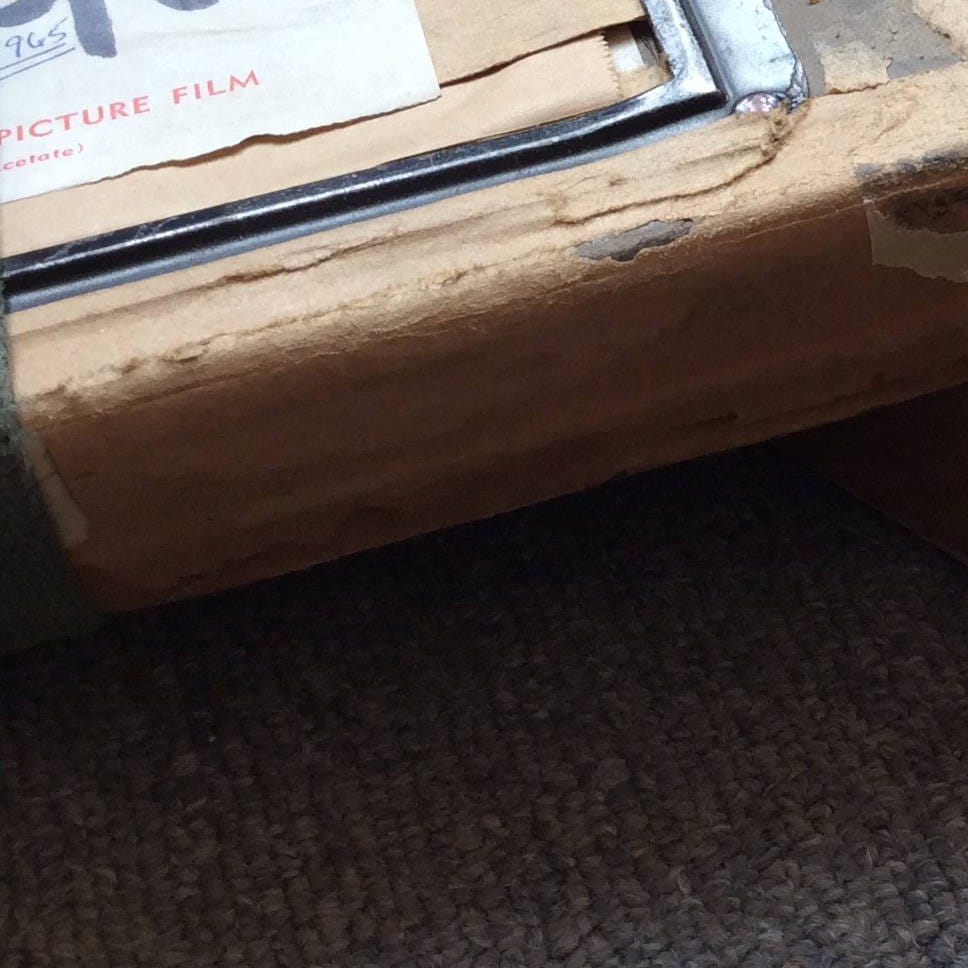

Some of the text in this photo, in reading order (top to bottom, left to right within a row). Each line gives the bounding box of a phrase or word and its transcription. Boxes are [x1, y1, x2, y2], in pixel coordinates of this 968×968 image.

[3, 17, 68, 58] 965
[0, 70, 260, 146] PICTURE FILM
[0, 143, 84, 171] cetate)
